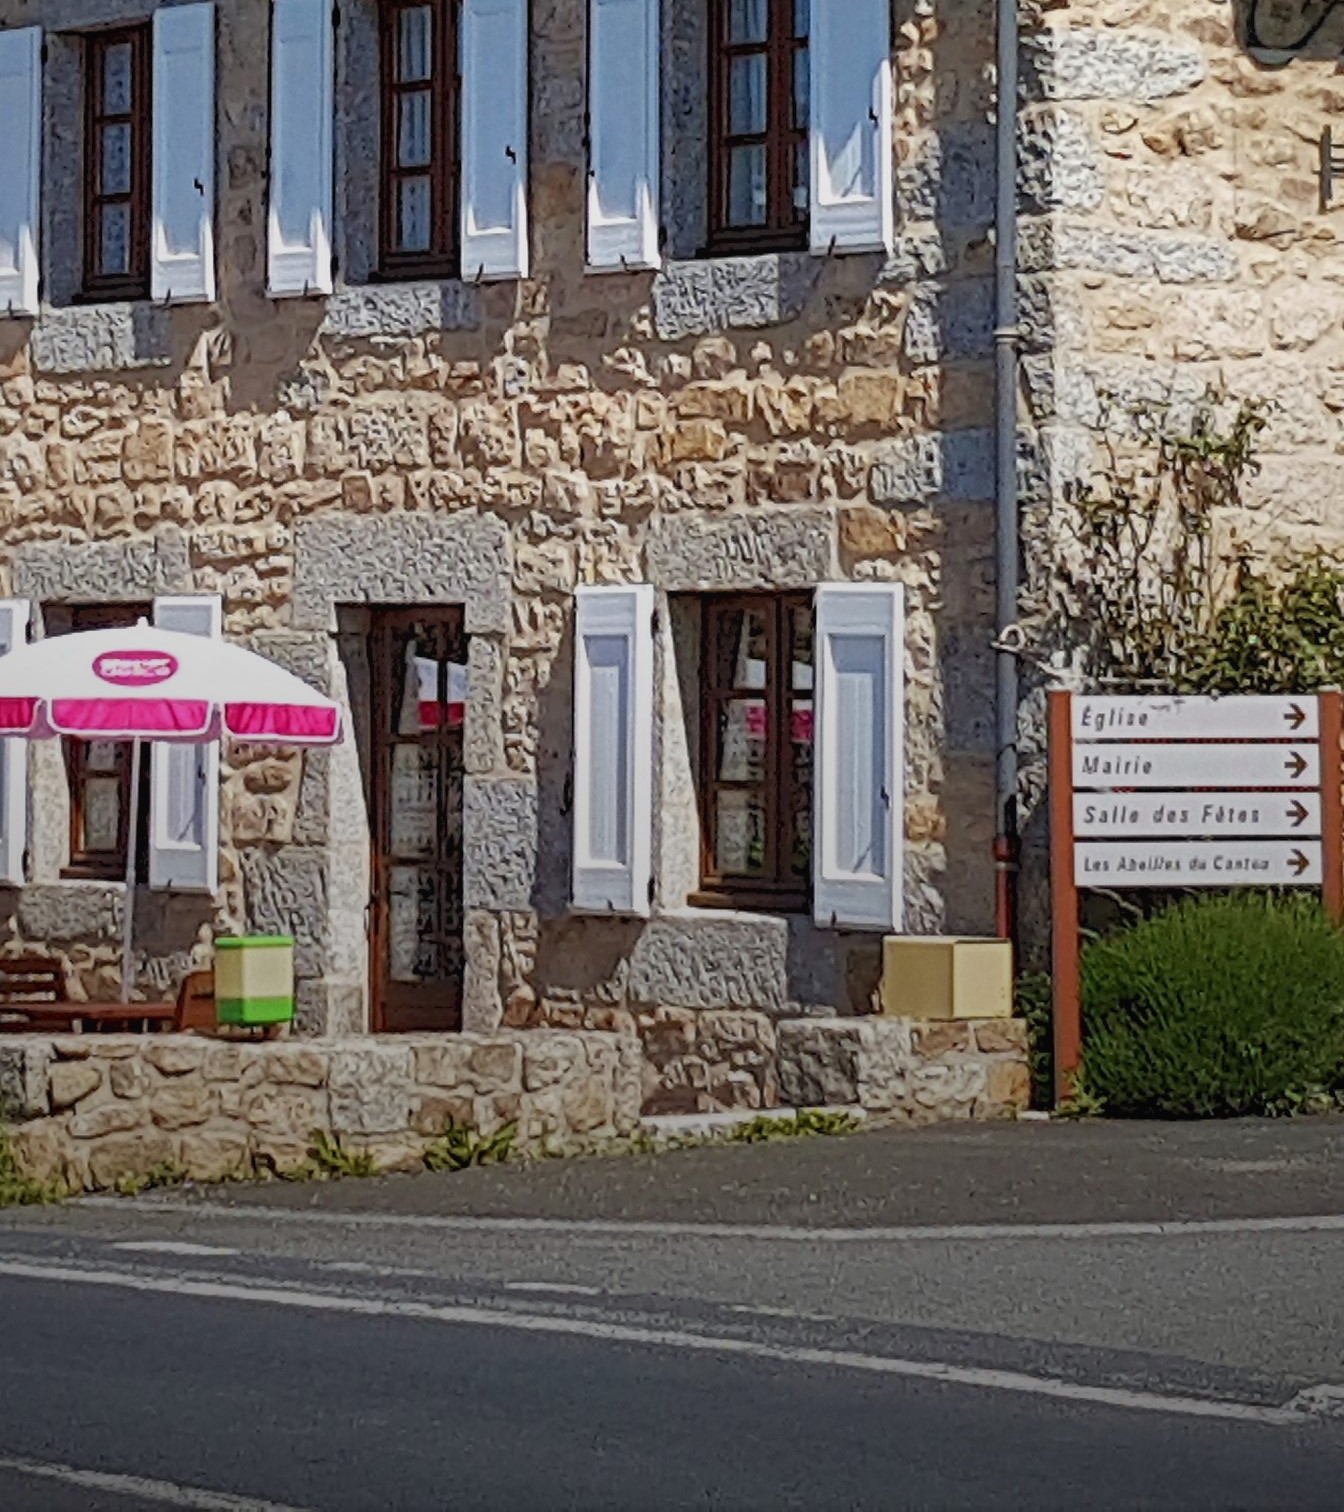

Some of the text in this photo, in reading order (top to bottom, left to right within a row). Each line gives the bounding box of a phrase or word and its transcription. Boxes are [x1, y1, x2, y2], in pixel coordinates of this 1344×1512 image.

[1081, 705, 1148, 732] Église
[1082, 755, 1153, 775] Mairie
[1083, 805, 1140, 824] Salle
[1152, 804, 1190, 824] des
[1084, 856, 1110, 872] Les
[1188, 855, 1207, 872] du
